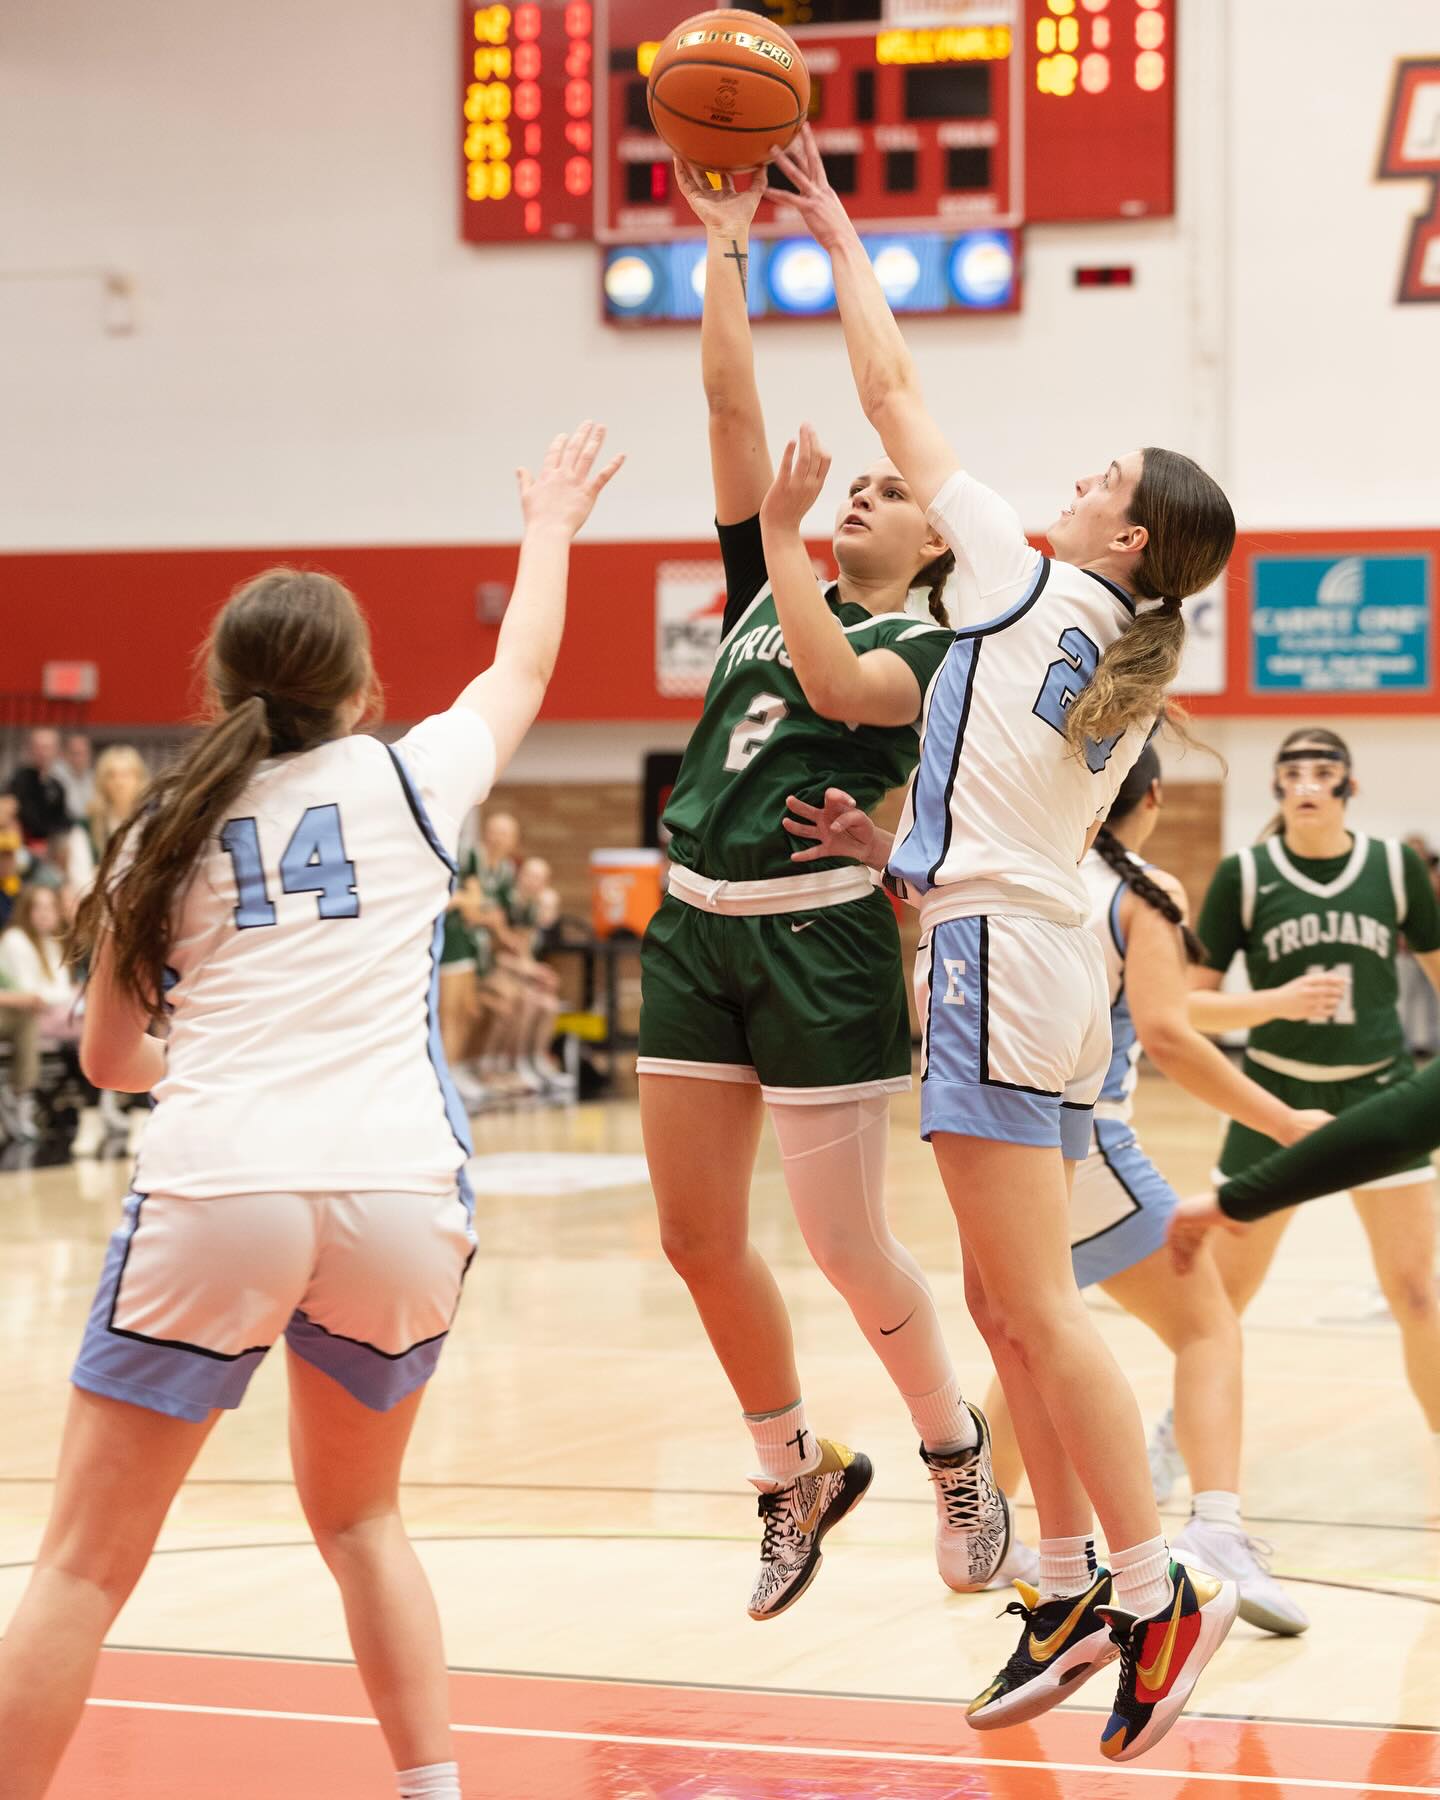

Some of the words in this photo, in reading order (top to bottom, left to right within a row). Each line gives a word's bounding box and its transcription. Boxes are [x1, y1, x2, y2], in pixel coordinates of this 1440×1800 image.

[761, 40, 794, 71] PRO
[722, 691, 790, 773] 2
[221, 802, 361, 932] 14
[1262, 909, 1392, 963] TROJANS
[942, 957, 967, 1006] E
